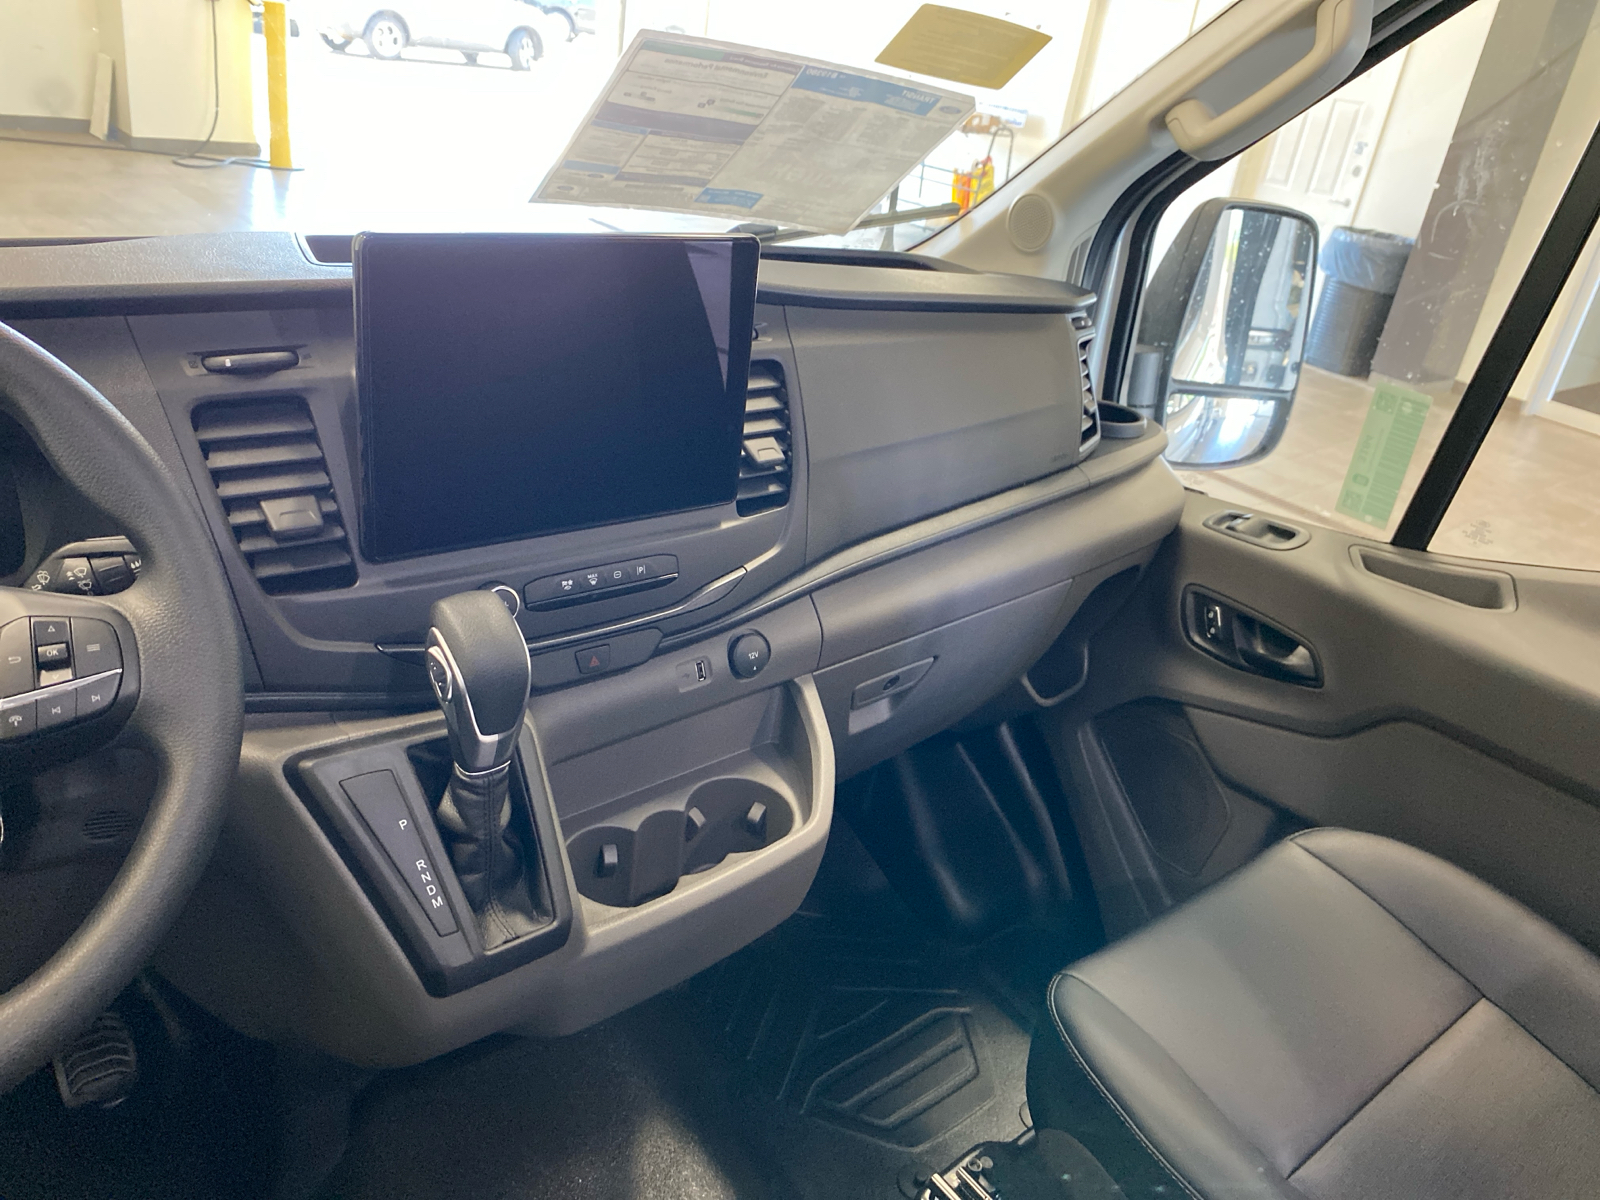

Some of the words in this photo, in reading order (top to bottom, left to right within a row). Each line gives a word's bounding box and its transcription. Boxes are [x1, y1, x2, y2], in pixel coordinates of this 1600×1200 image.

[46, 648, 59, 657] OK
[748, 650, 759, 660] 12V
[398, 819, 408, 830] P
[415, 859, 427, 871] R
[421, 871, 432, 883] N
[426, 884, 436, 896] D
[431, 895, 443, 908] M
